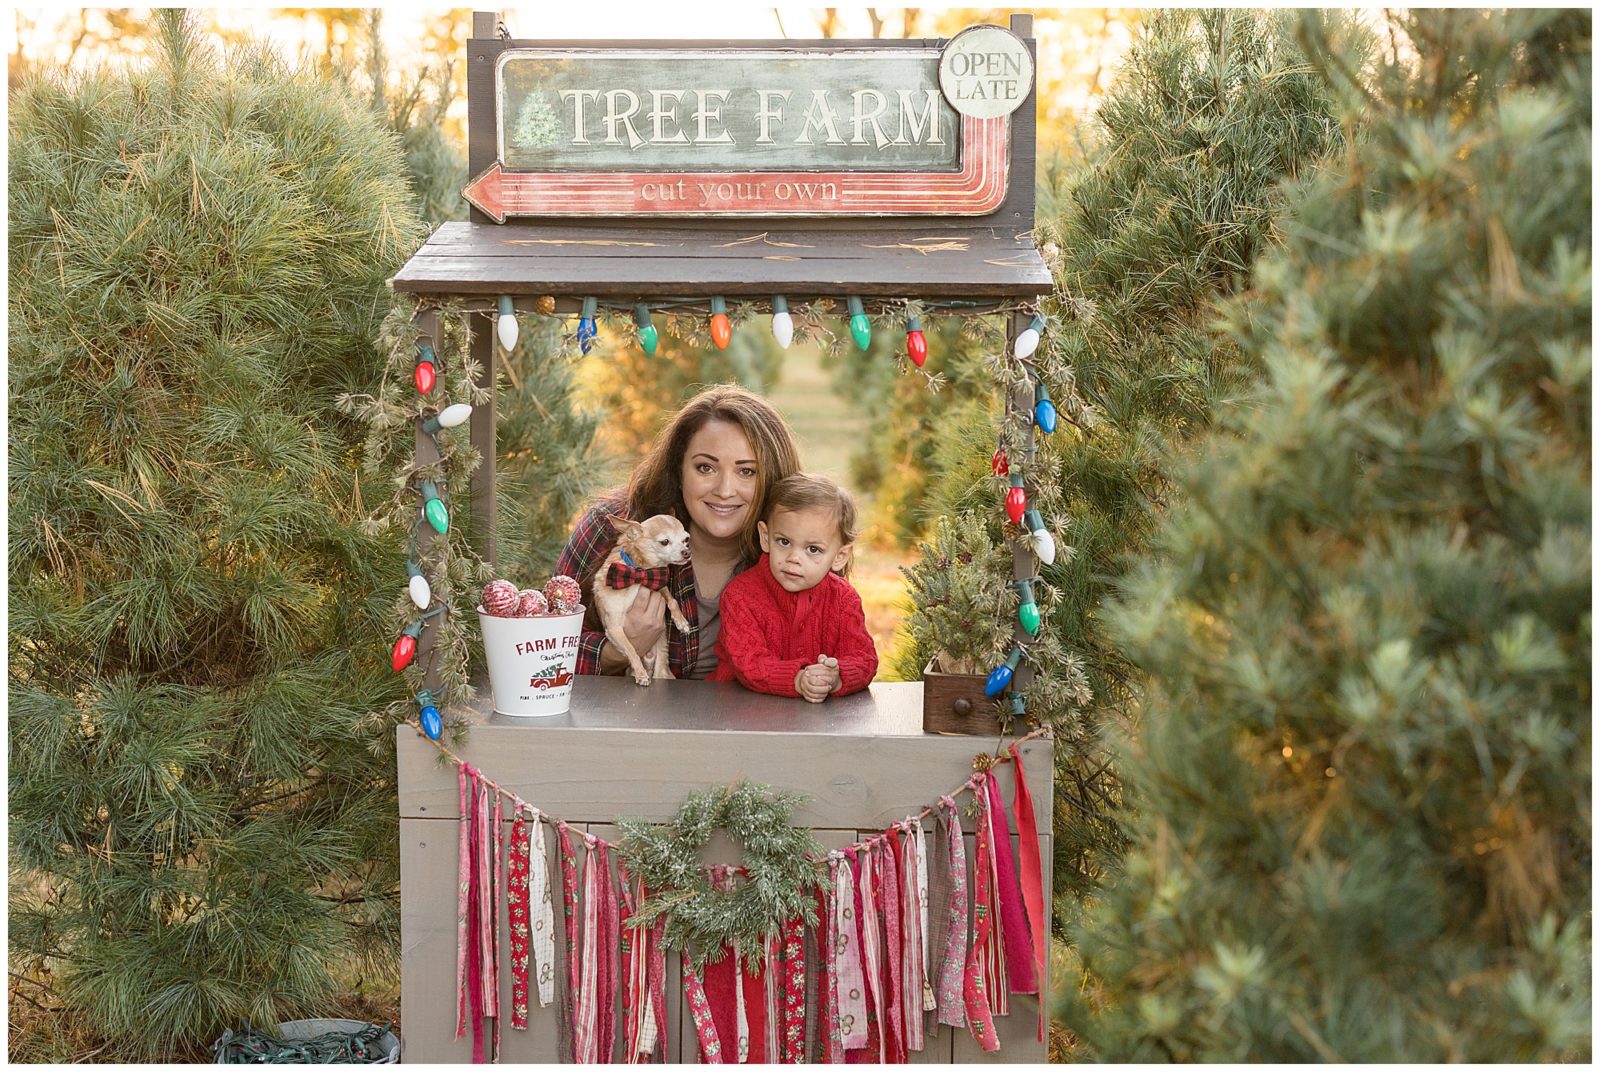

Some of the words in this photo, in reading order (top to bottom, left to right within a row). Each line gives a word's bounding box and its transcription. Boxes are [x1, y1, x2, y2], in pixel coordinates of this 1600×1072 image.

[949, 51, 1023, 79] OPEN
[954, 79, 1020, 102] LATE
[557, 89, 738, 151] TREE
[753, 89, 945, 151] FARM
[640, 177, 687, 202] cut
[697, 181, 769, 205] your
[775, 183, 840, 202] own
[516, 638, 557, 656] FARM
[561, 636, 579, 649] FRE
[535, 693, 555, 701] SPRUCE
